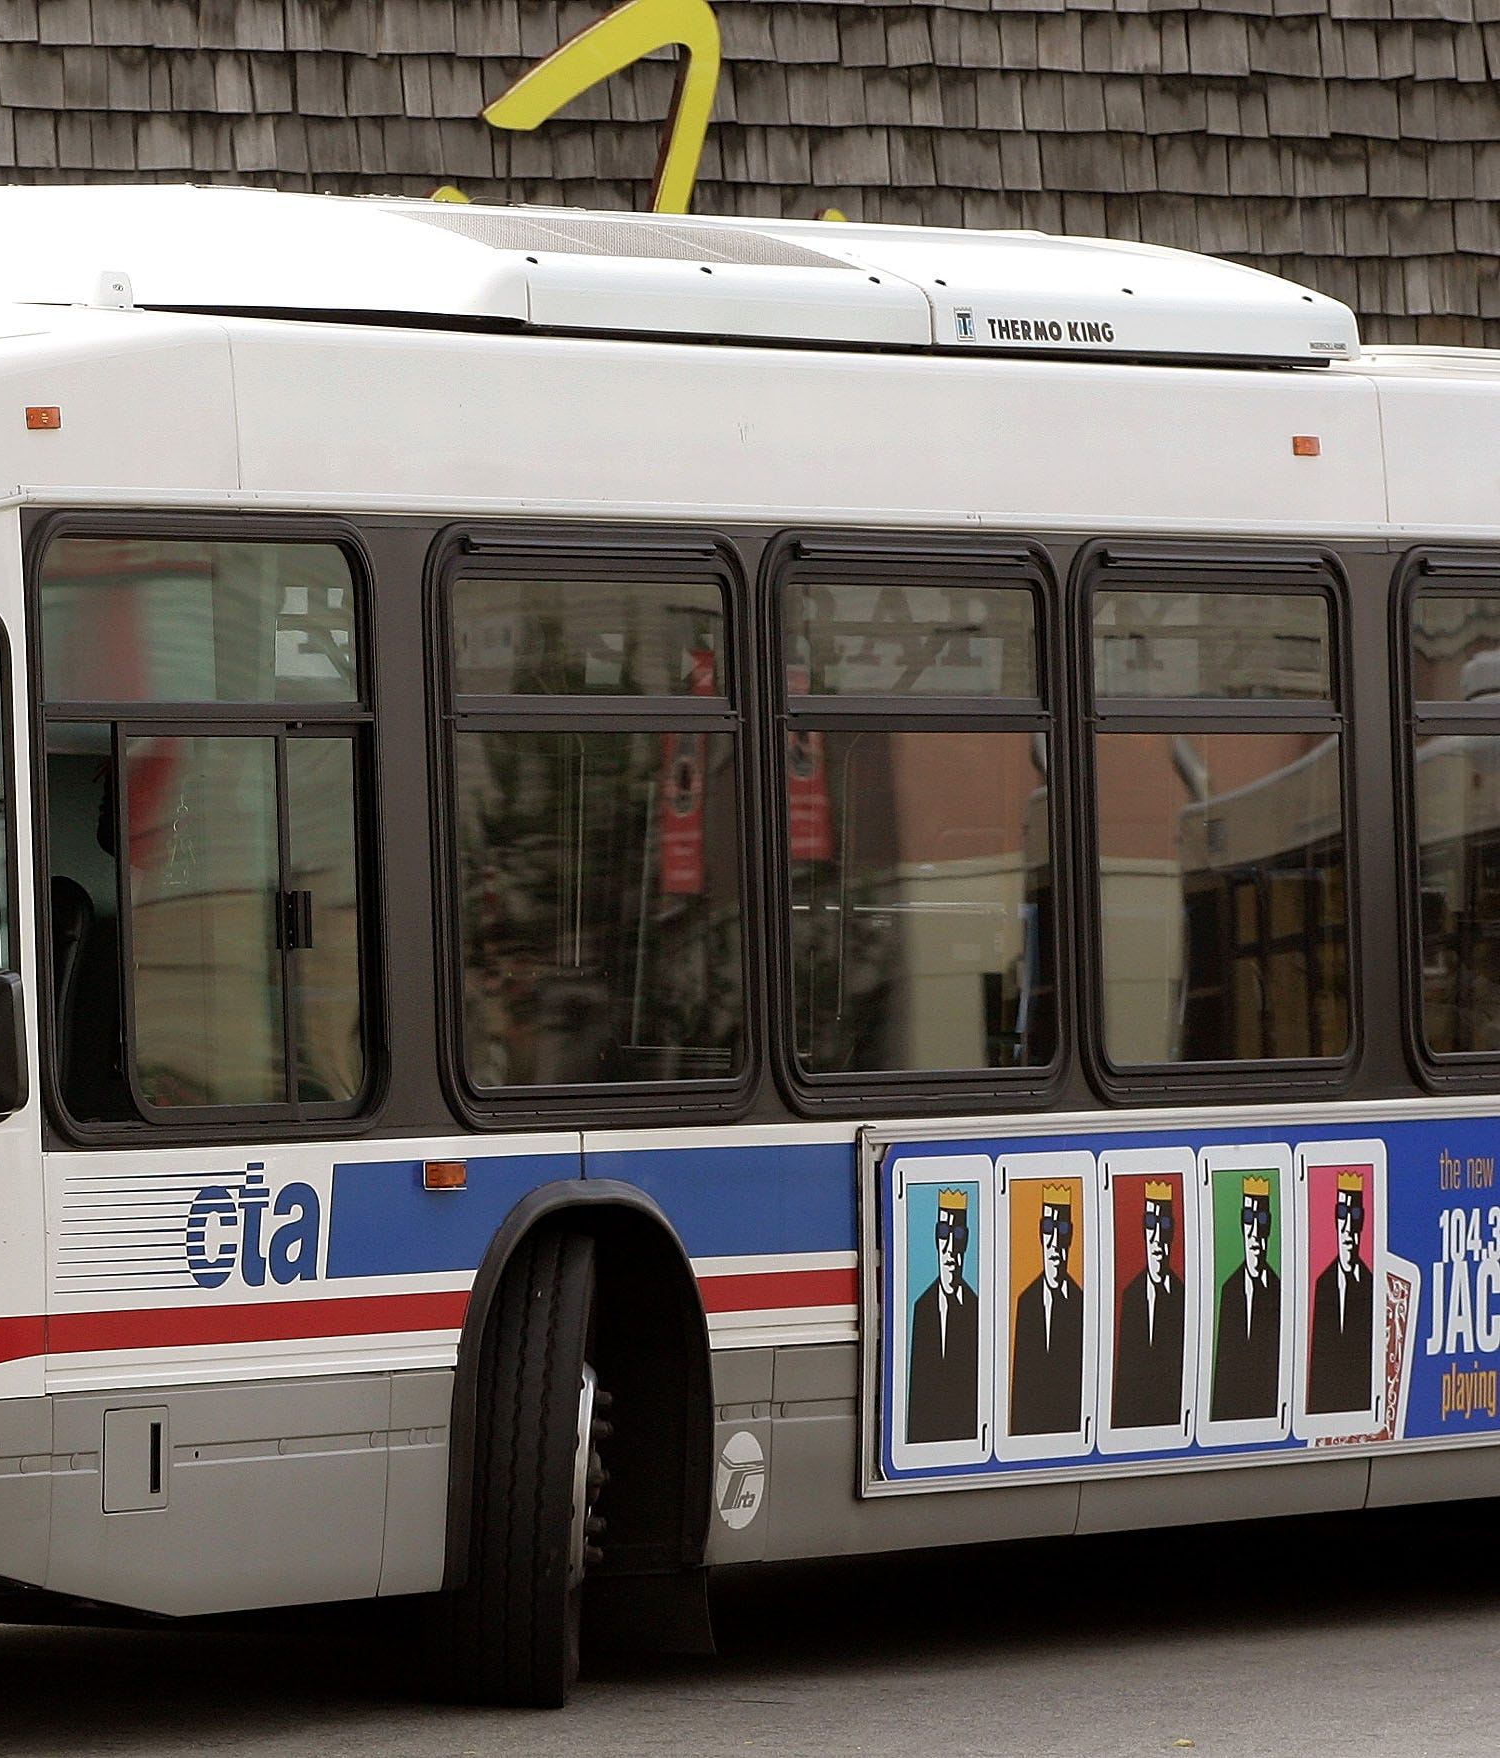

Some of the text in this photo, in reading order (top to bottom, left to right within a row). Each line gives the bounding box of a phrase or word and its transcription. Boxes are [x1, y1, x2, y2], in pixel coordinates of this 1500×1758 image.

[987, 318, 1115, 343] THERMO KING
[1439, 1148, 1494, 1190] the new
[186, 1162, 321, 1289] cta
[1439, 1206, 1500, 1263] 104.3
[1426, 1258, 1500, 1356] JAC
[1442, 1361, 1498, 1421] playing
